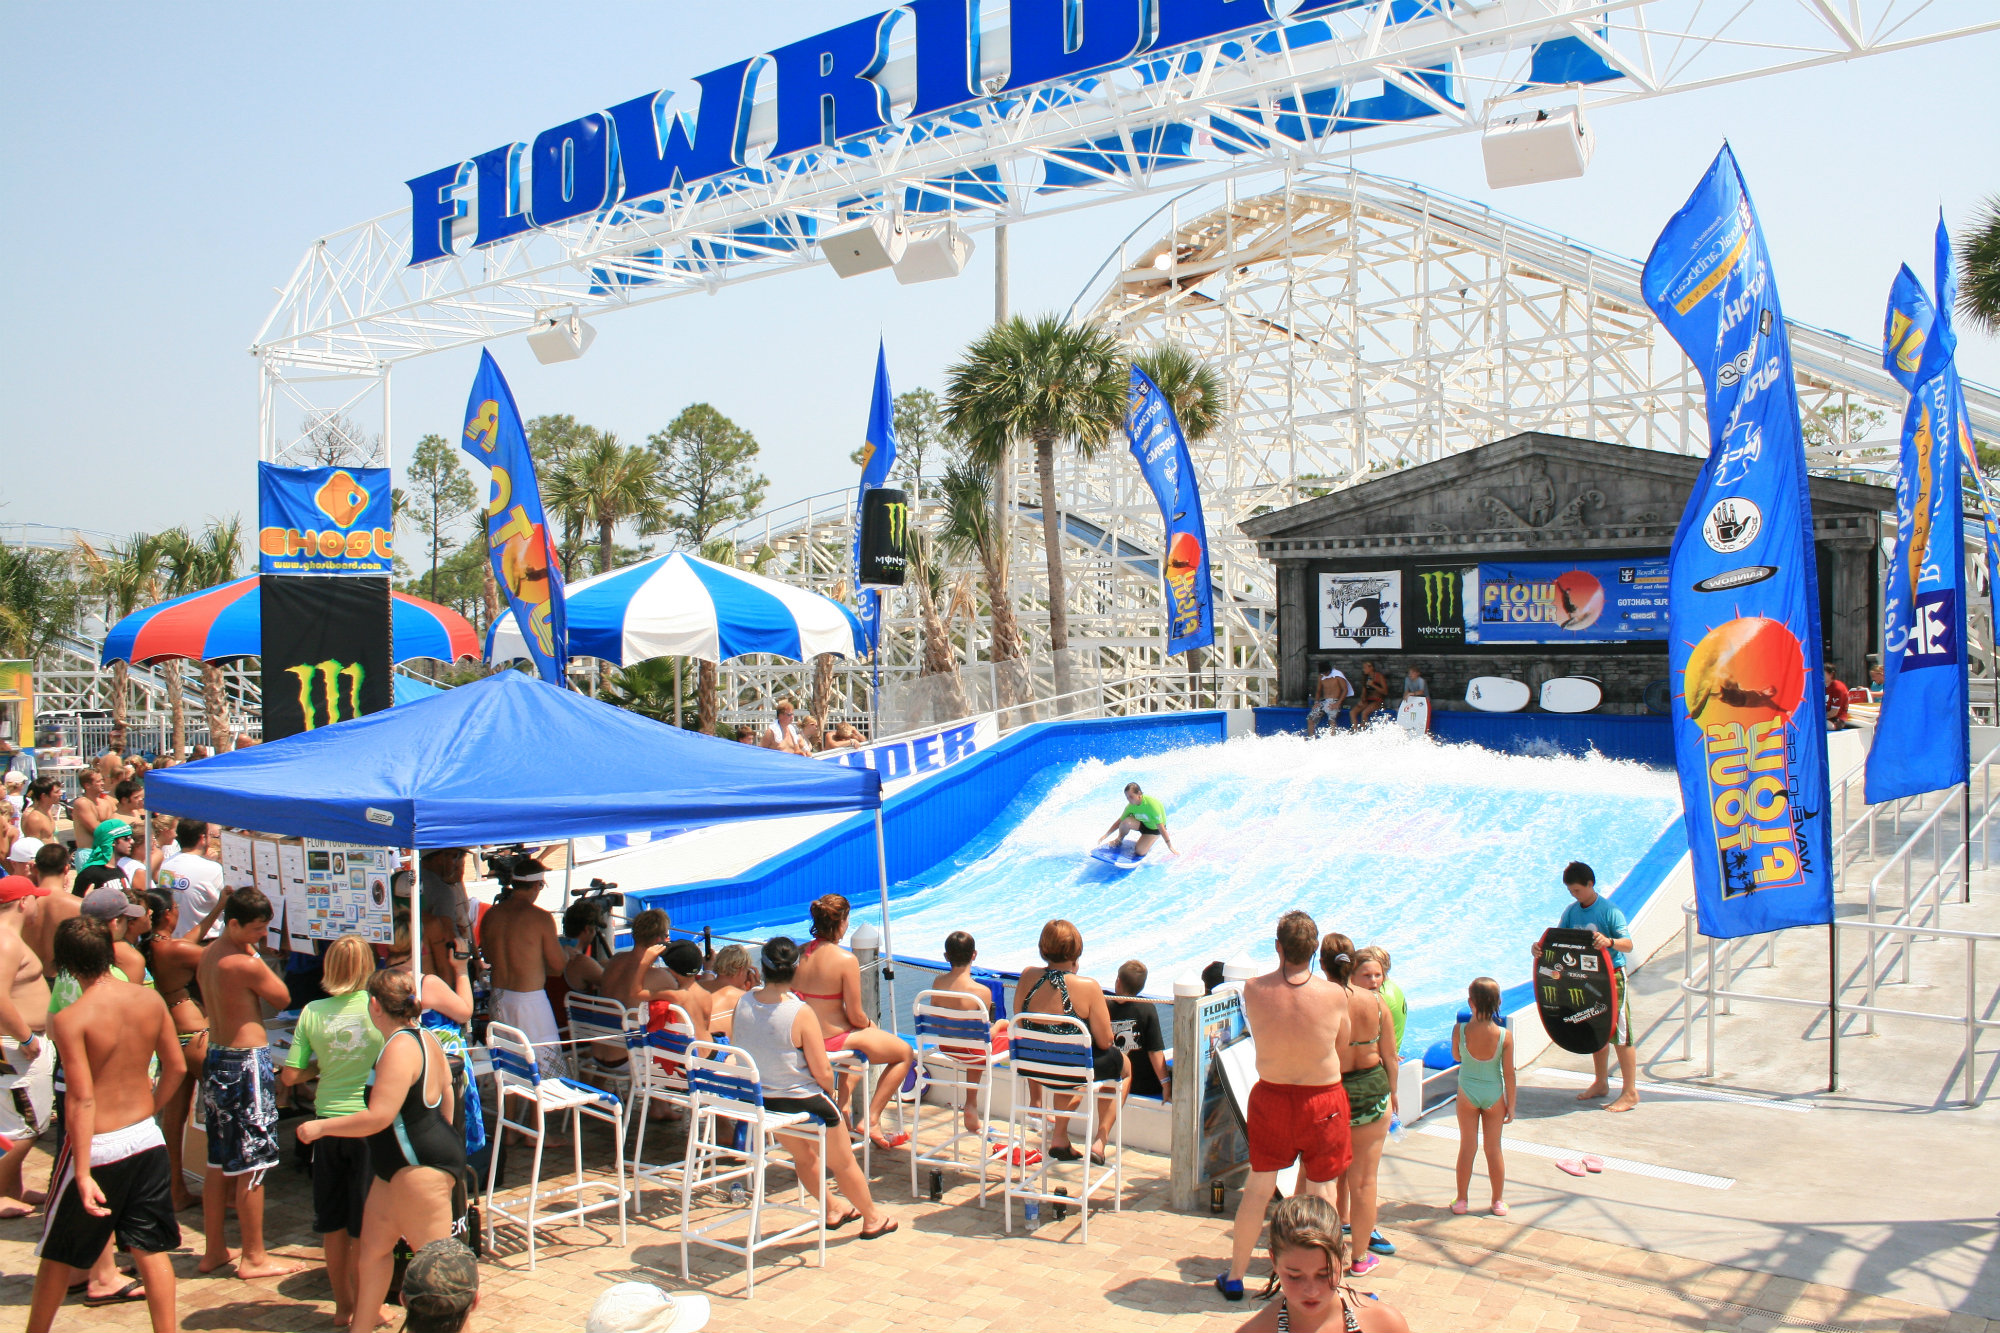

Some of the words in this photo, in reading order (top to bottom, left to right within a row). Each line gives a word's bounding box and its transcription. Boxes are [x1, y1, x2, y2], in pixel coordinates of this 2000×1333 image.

[405, 0, 1376, 269] FLOWRID
[274, 560, 382, 570] www.ghostboard.com
[1484, 583, 1556, 606] FLOW
[1500, 604, 1558, 622] TOUR
[1333, 627, 1389, 637] FLOWRIDER
[1417, 625, 1462, 635] MONSTER
[1203, 995, 1241, 1017] FLOWRI
